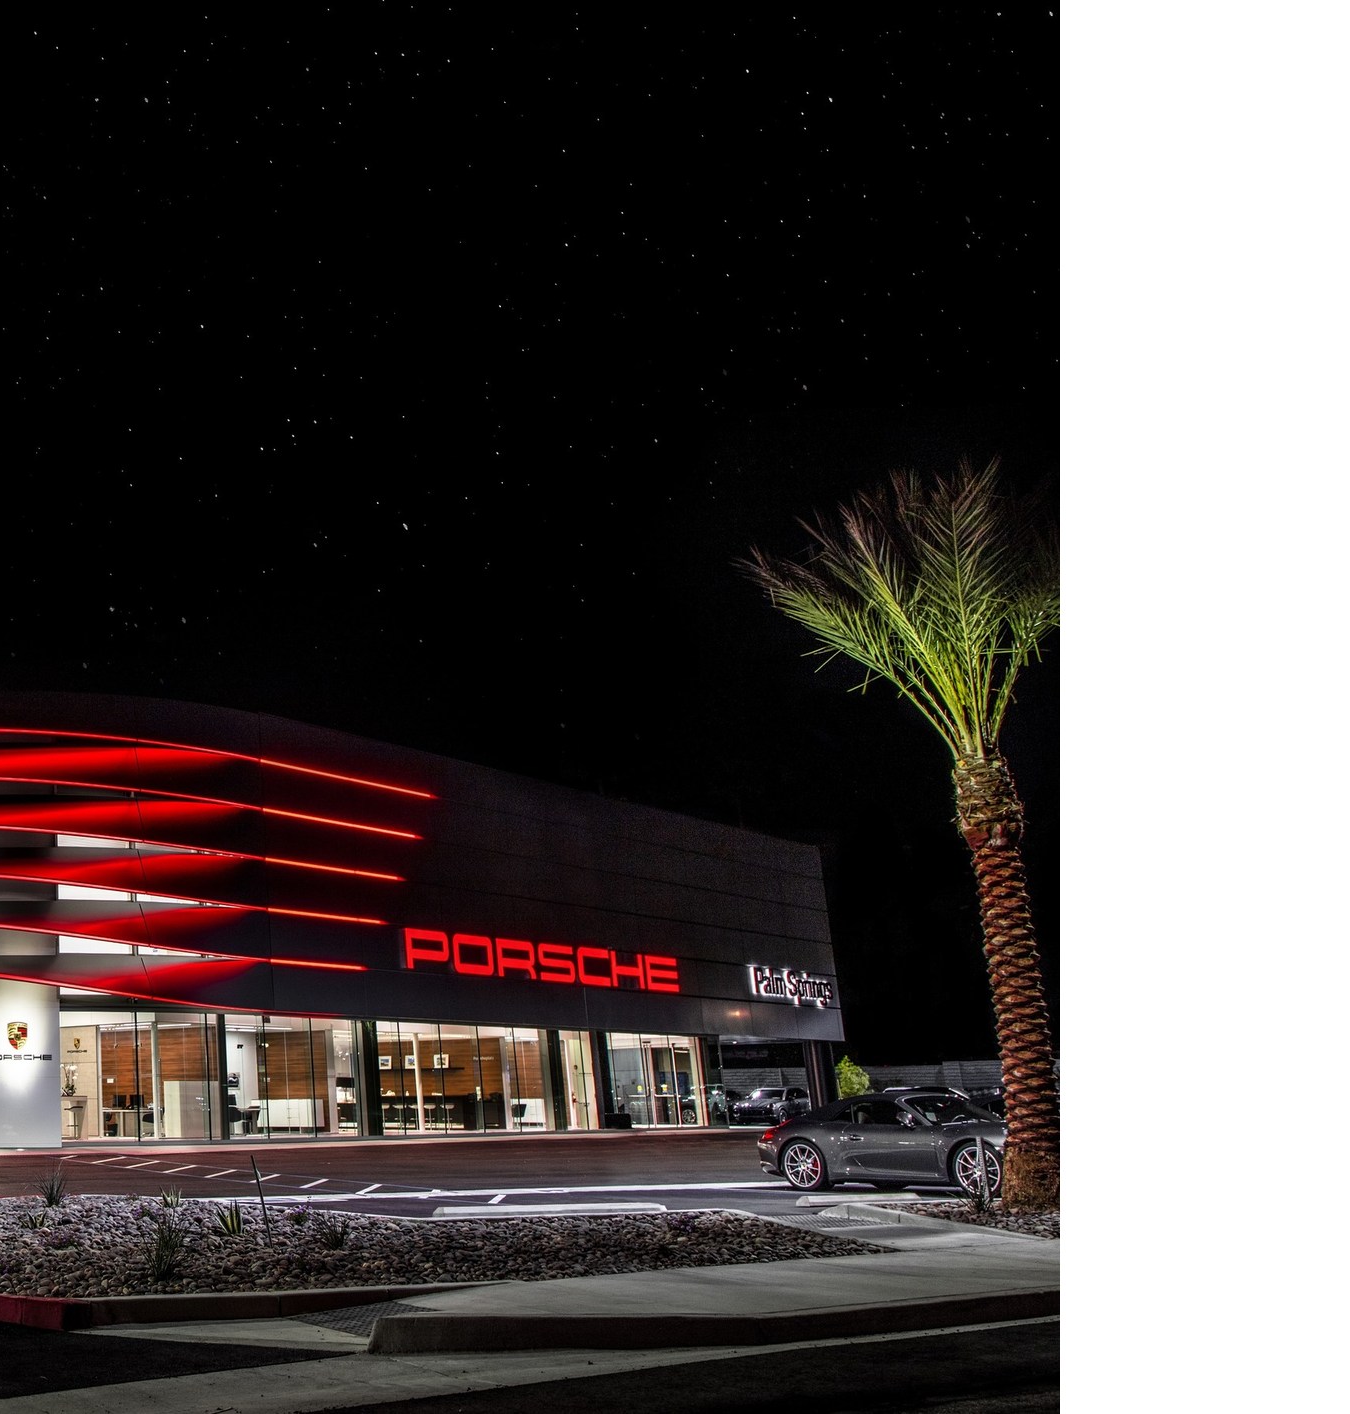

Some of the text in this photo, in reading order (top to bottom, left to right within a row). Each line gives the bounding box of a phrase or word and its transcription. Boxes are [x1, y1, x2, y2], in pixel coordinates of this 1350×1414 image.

[404, 927, 680, 993] PORSCHE
[750, 965, 834, 1007] Palm Springs
